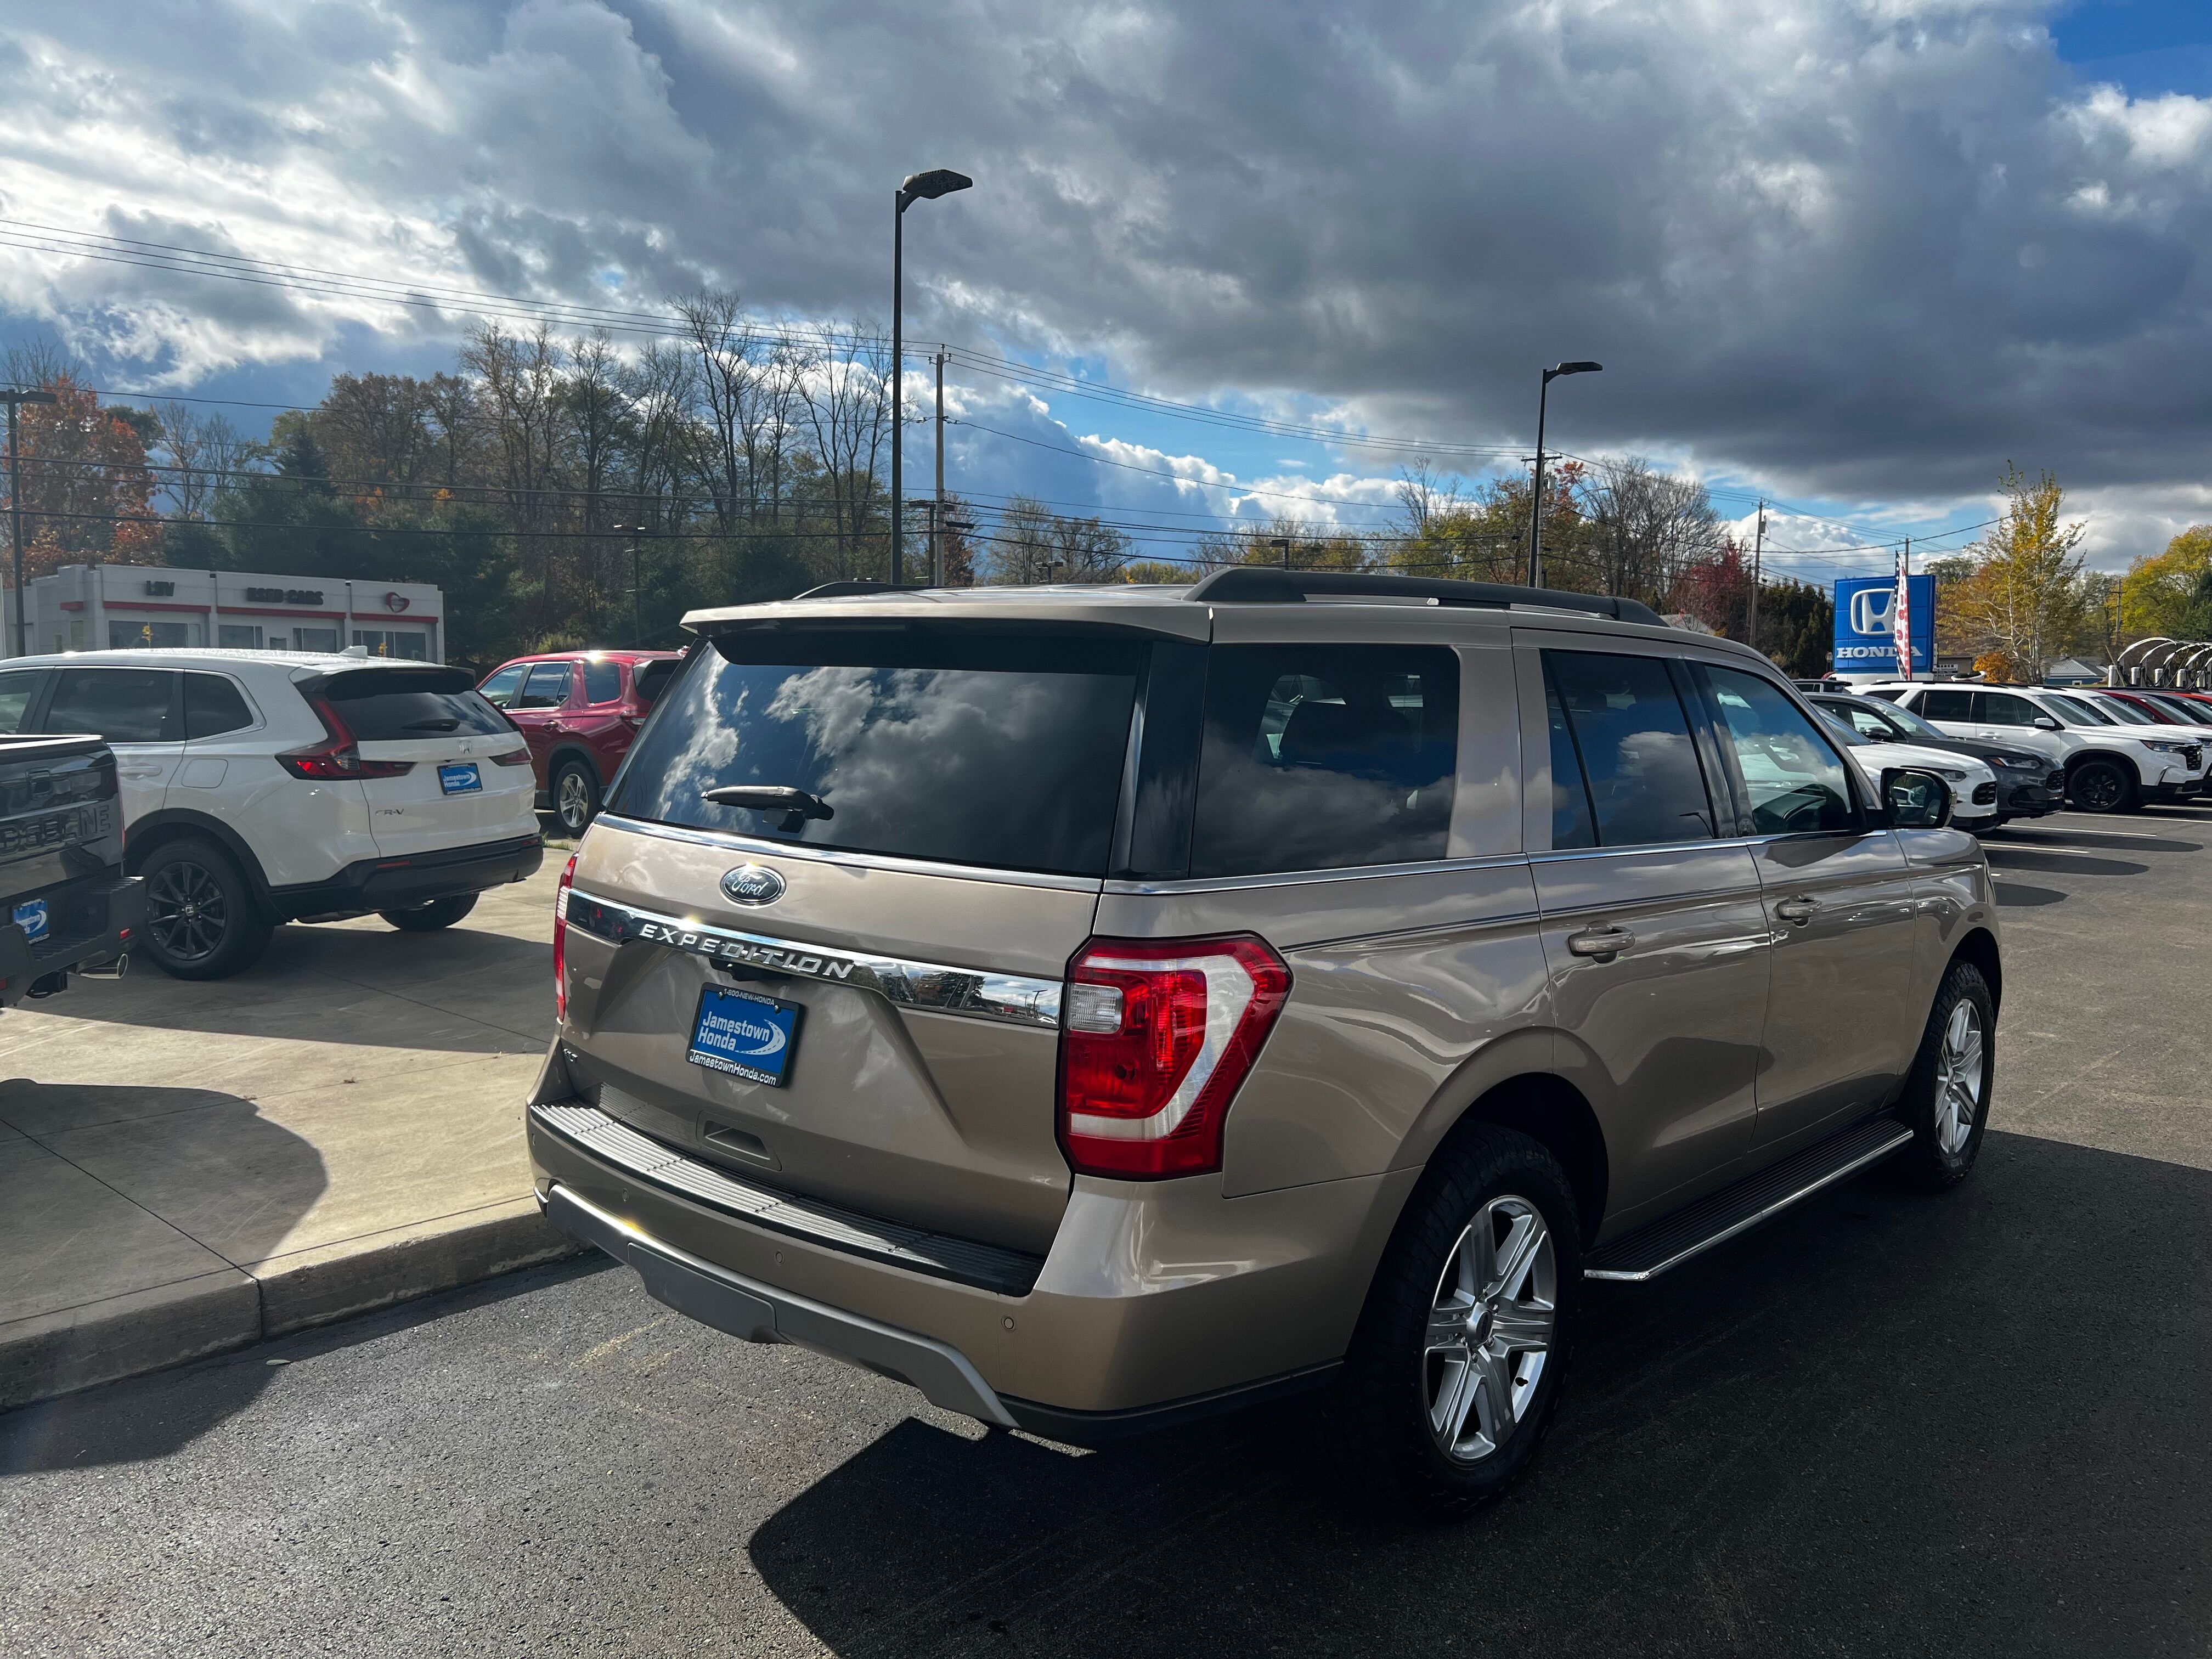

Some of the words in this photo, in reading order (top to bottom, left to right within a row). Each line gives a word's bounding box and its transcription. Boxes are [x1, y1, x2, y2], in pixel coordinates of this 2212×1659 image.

[732, 870, 769, 896] Ford
[639, 923, 854, 978] EXPEDITION
[724, 988, 775, 1006] 1-800-NEW-HONDA
[697, 1026, 737, 1052] Honda
[702, 1011, 770, 1042] Jamestown
[689, 1051, 777, 1086] JamestownHonda.com
